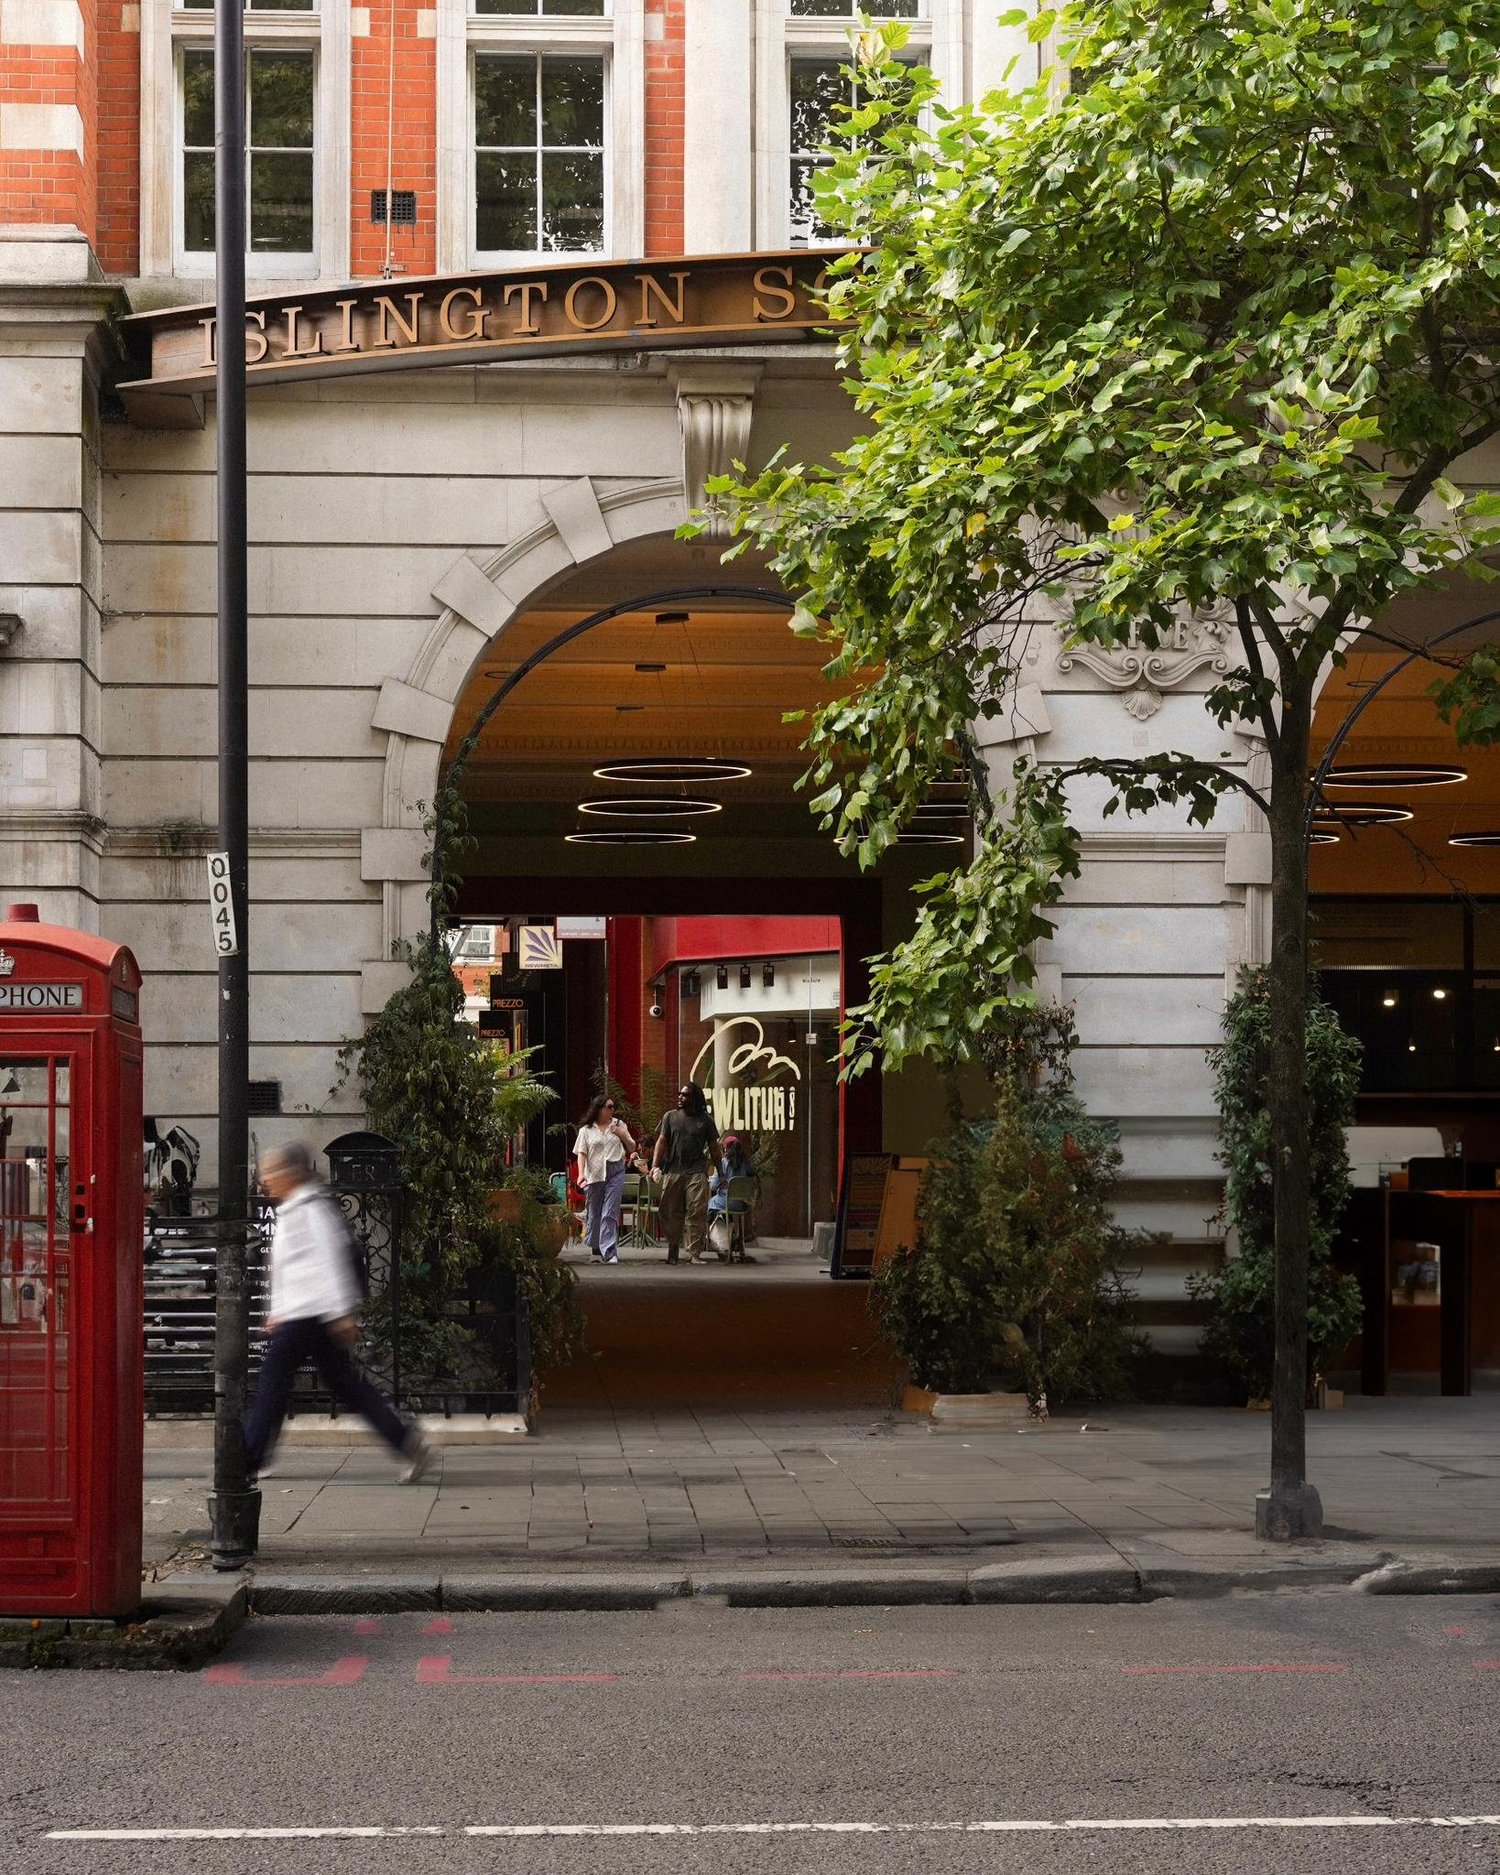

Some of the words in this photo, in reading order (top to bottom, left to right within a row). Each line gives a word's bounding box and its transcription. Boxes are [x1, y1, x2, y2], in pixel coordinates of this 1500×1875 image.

[199, 272, 691, 368] ISLINGTON
[211, 857, 232, 951] 0045
[491, 999, 524, 1008] PREZZO
[480, 1029, 506, 1037] PREZZO
